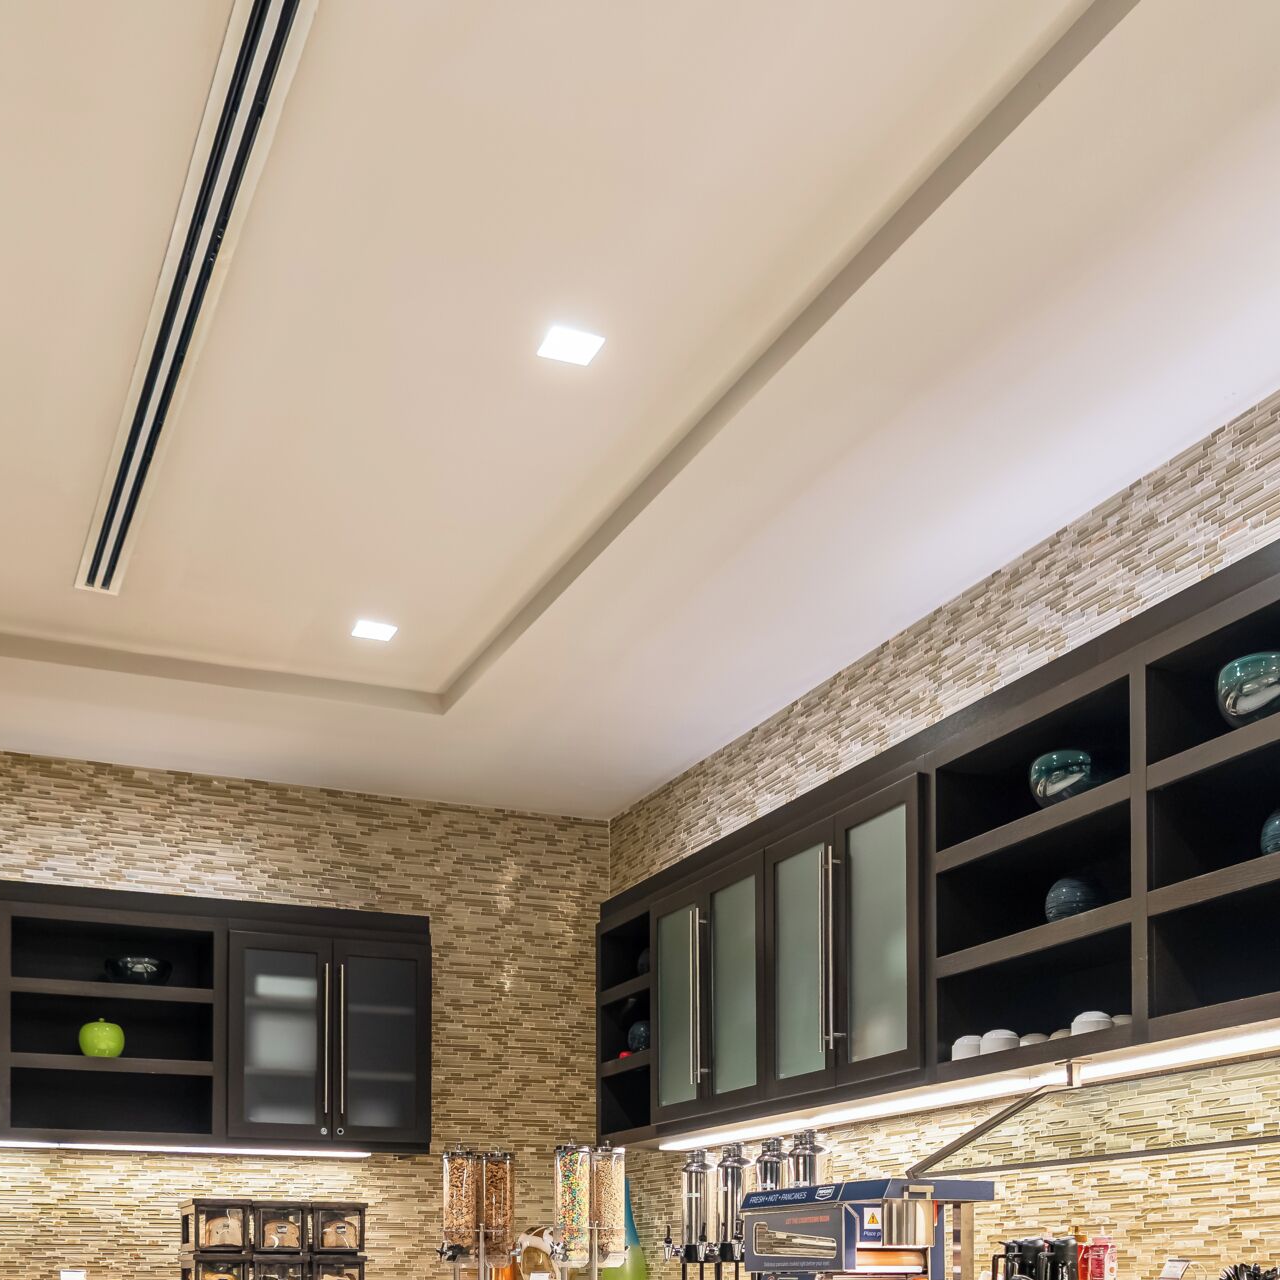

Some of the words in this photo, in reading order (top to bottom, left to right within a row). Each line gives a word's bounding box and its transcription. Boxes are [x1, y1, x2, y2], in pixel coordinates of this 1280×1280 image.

[749, 1196, 766, 1204] FRESH
[768, 1194, 779, 1202] HOT
[781, 1191, 807, 1201] PANCAKES
